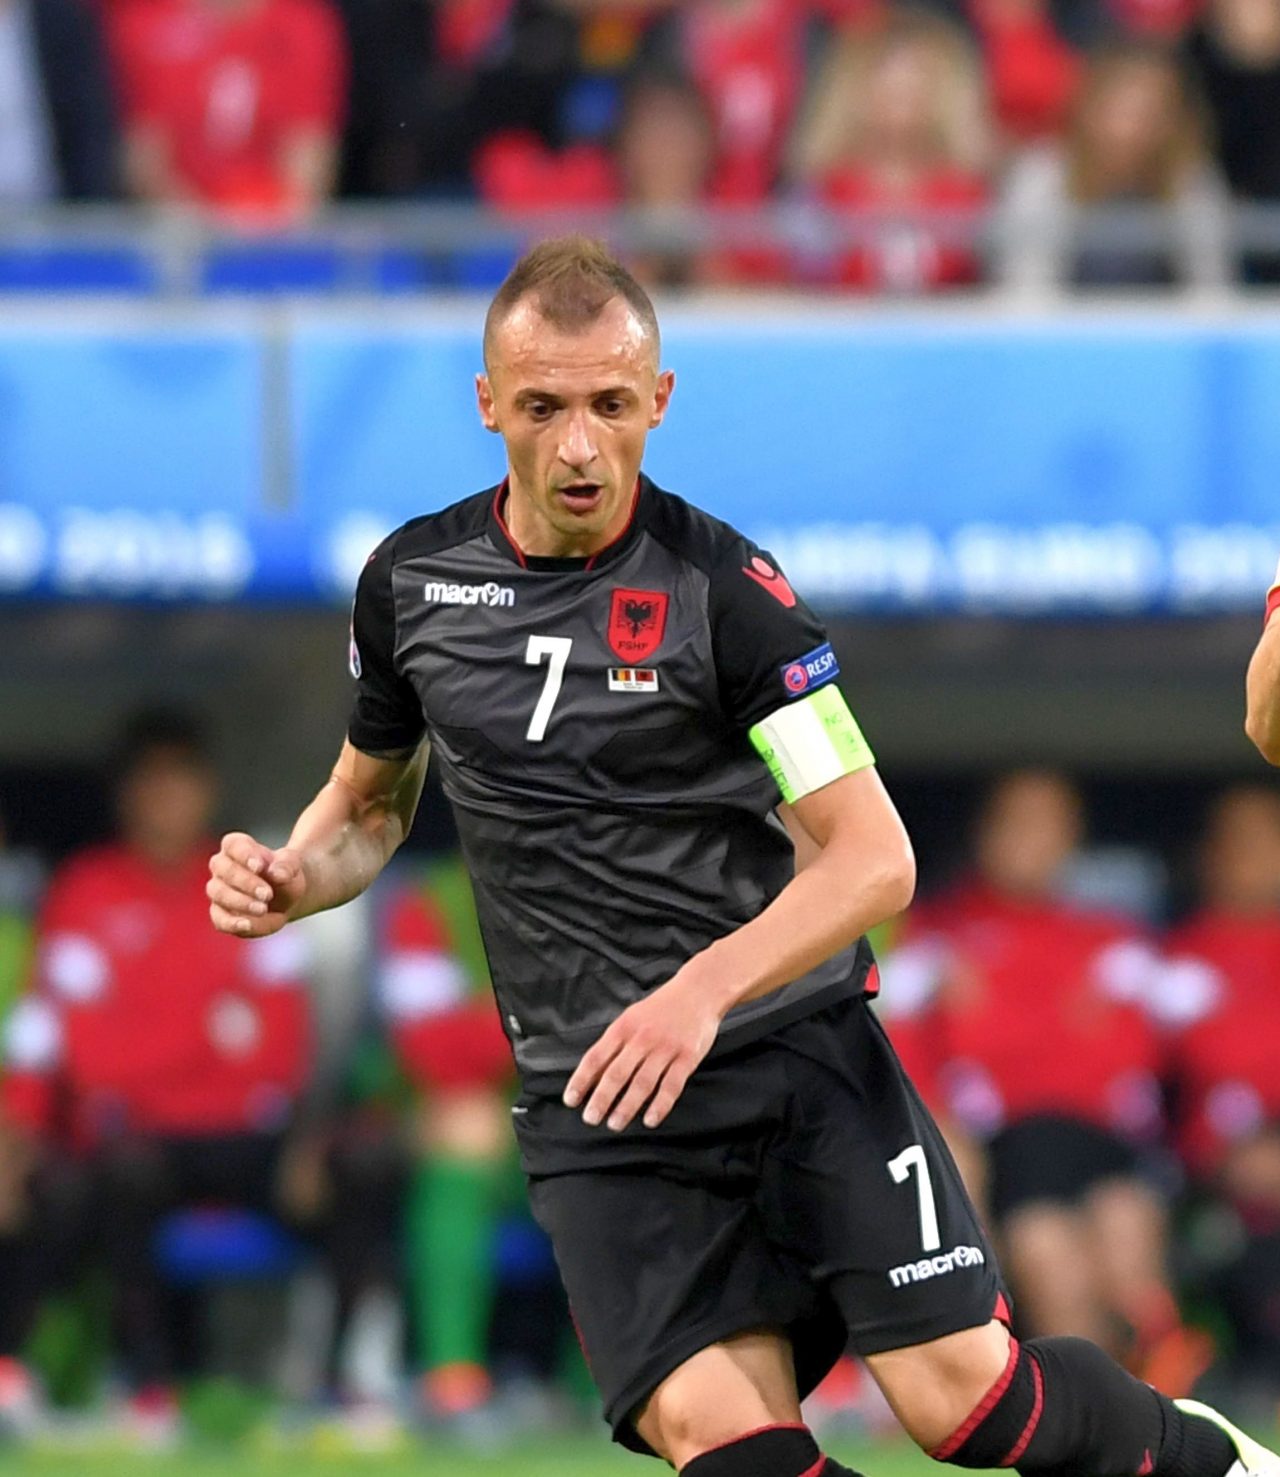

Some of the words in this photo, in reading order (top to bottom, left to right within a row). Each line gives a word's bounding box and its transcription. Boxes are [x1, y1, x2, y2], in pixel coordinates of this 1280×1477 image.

[424, 582, 515, 607] macron
[806, 652, 837, 678] RESP
[525, 634, 573, 741] 7
[887, 1144, 941, 1251] 7
[888, 1245, 984, 1287] macron
